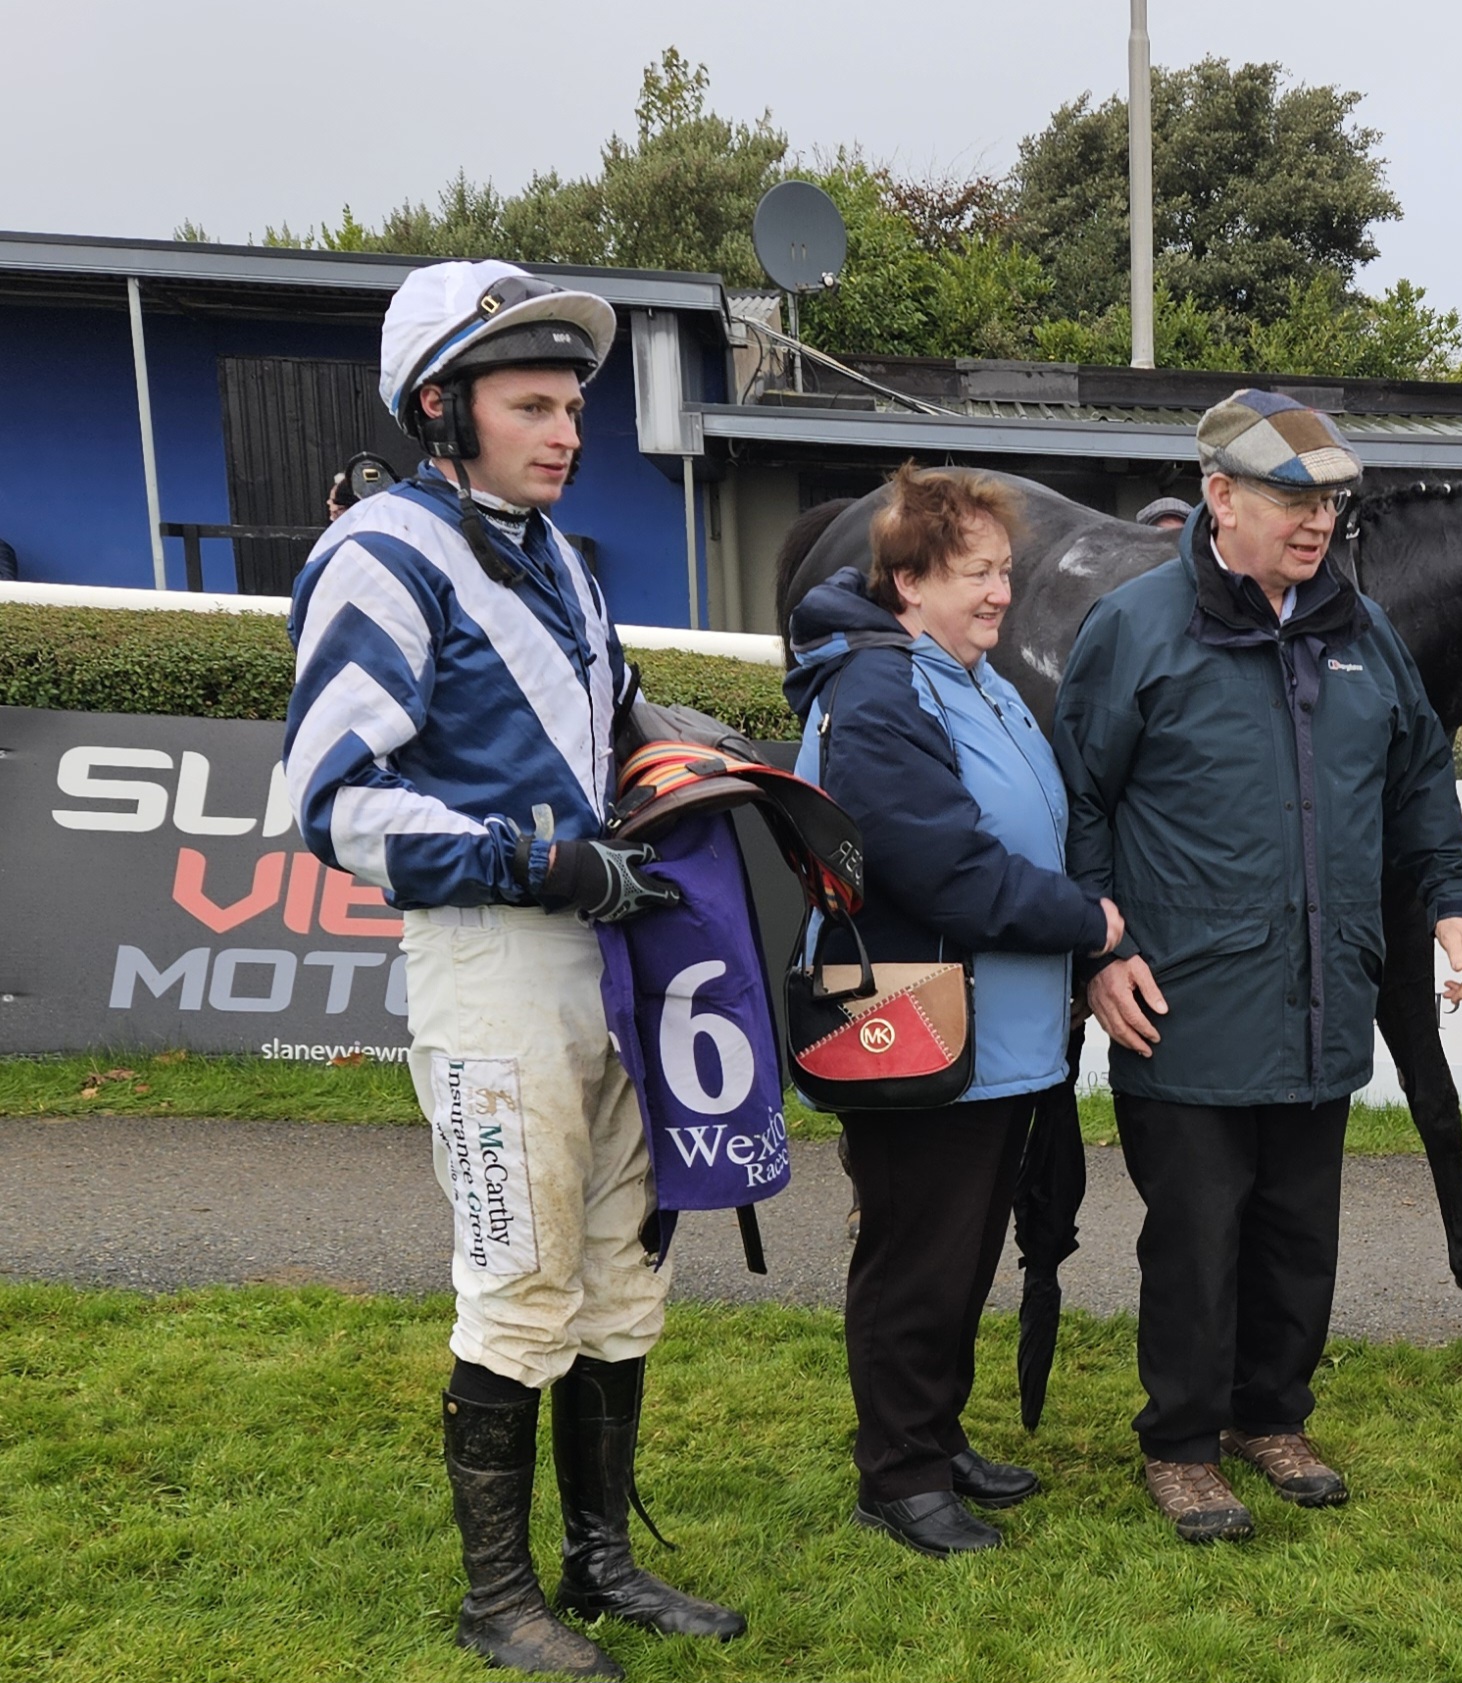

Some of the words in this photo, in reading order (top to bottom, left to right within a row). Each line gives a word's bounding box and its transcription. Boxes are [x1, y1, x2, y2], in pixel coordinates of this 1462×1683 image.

[52, 746, 293, 837] SL
[109, 944, 410, 1016] MOT
[659, 959, 755, 1115] 6
[863, 1028, 892, 1046] MK
[448, 1060, 475, 1185] Insurance
[467, 1190, 488, 1268] Group
[478, 1123, 515, 1247] McCarthy
